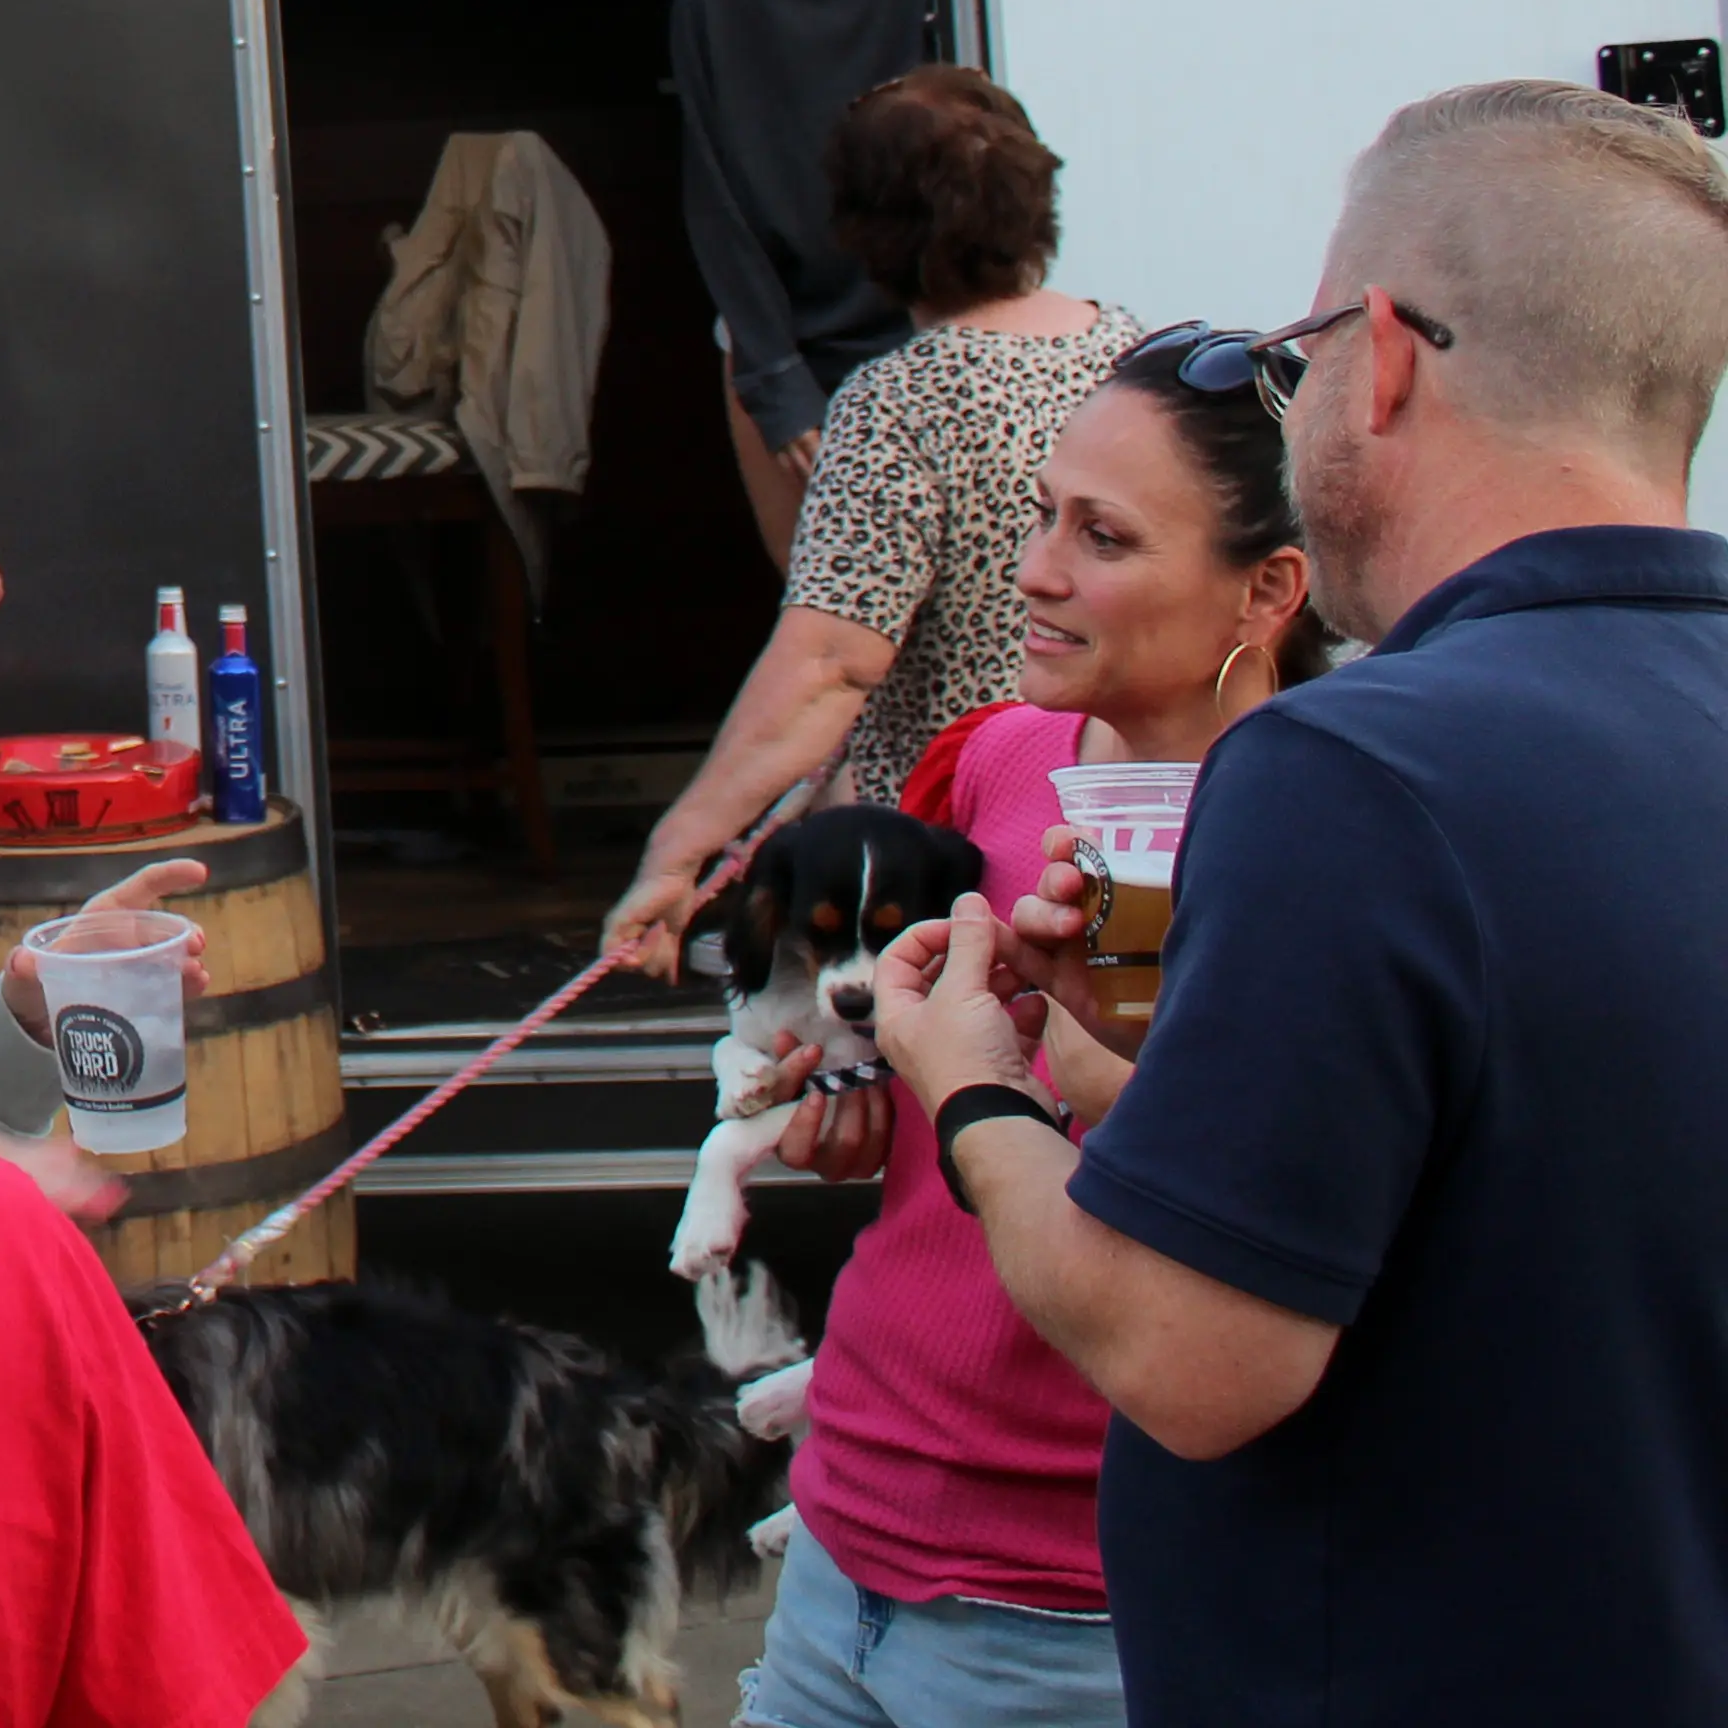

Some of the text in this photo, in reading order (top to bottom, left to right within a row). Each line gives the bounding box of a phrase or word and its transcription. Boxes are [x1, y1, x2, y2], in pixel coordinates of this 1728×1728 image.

[228, 700, 249, 779] ULTRA
[67, 1030, 115, 1052] TRUCK
[71, 1051, 119, 1080] YARD
